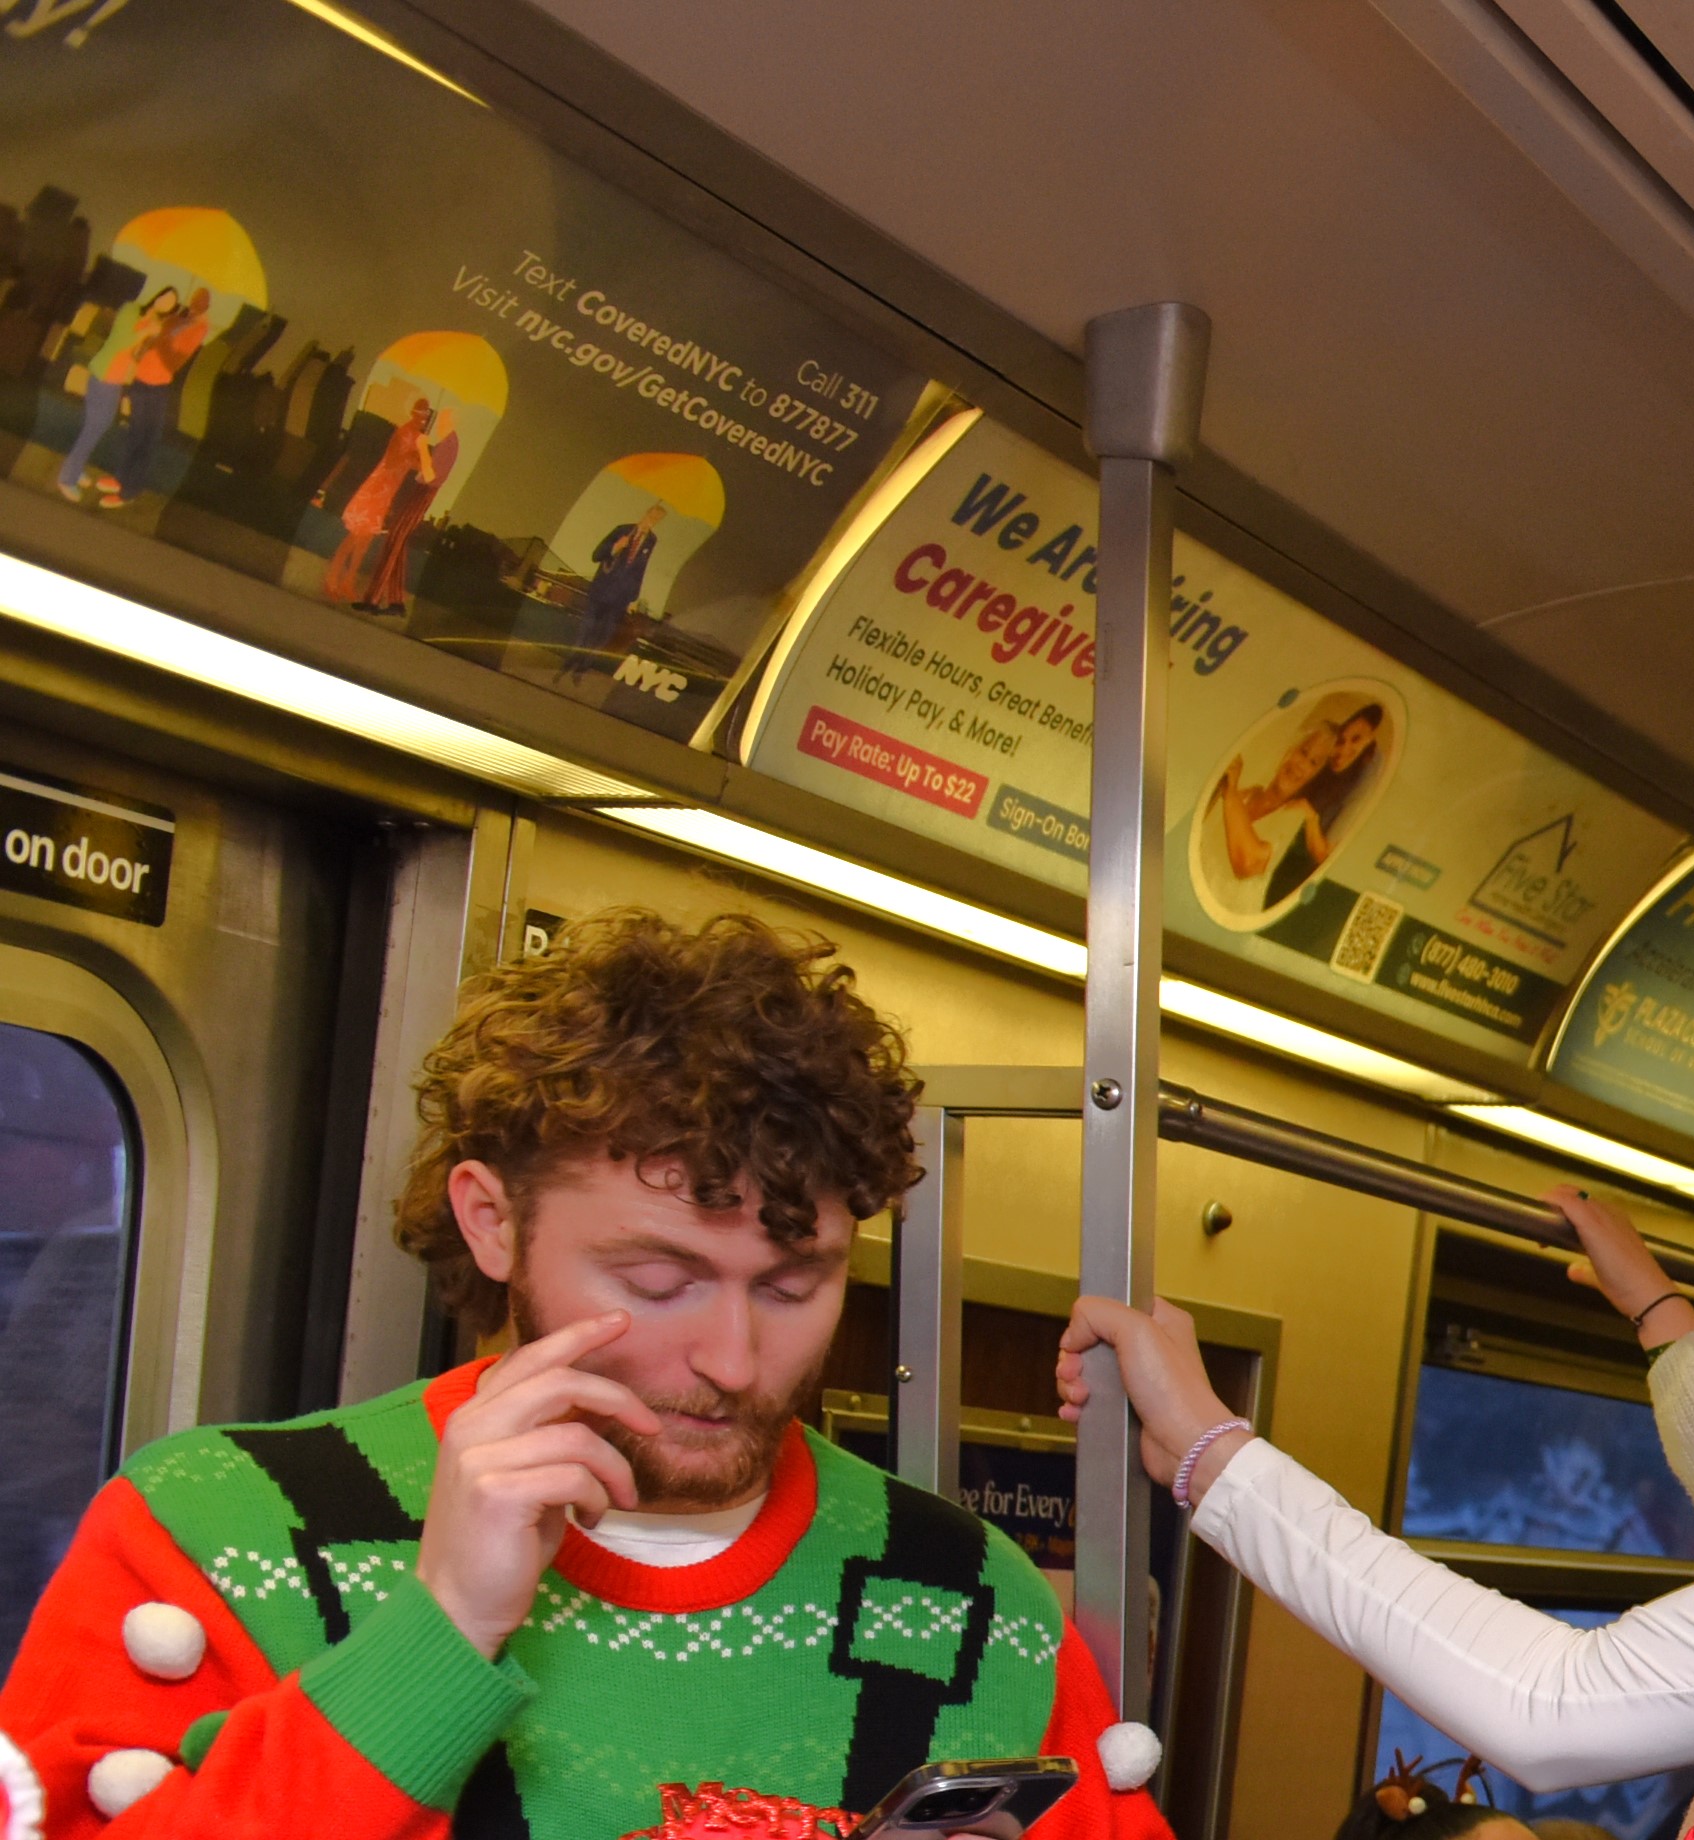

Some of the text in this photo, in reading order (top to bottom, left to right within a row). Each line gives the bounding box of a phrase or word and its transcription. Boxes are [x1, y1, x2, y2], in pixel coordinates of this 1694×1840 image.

[451, 265, 834, 487] Visit nyc.gov/GetCoveredNYC
[512, 250, 859, 454] Text CoveredNYC to 877877
[796, 359, 880, 420] Call 311
[893, 543, 1096, 680] Caregive
[951, 472, 1039, 551] We
[1170, 574, 1249, 677] ring
[613, 654, 688, 702] NYC
[826, 653, 1024, 758] Holiday Pay, & More!
[847, 614, 1094, 746] Flexible Hours, Great Benef
[809, 720, 977, 804] Pay Rate: Up To $22
[5, 828, 151, 895] on door
[999, 796, 1067, 840] Sign-On
[982, 1480, 1014, 1516] for
